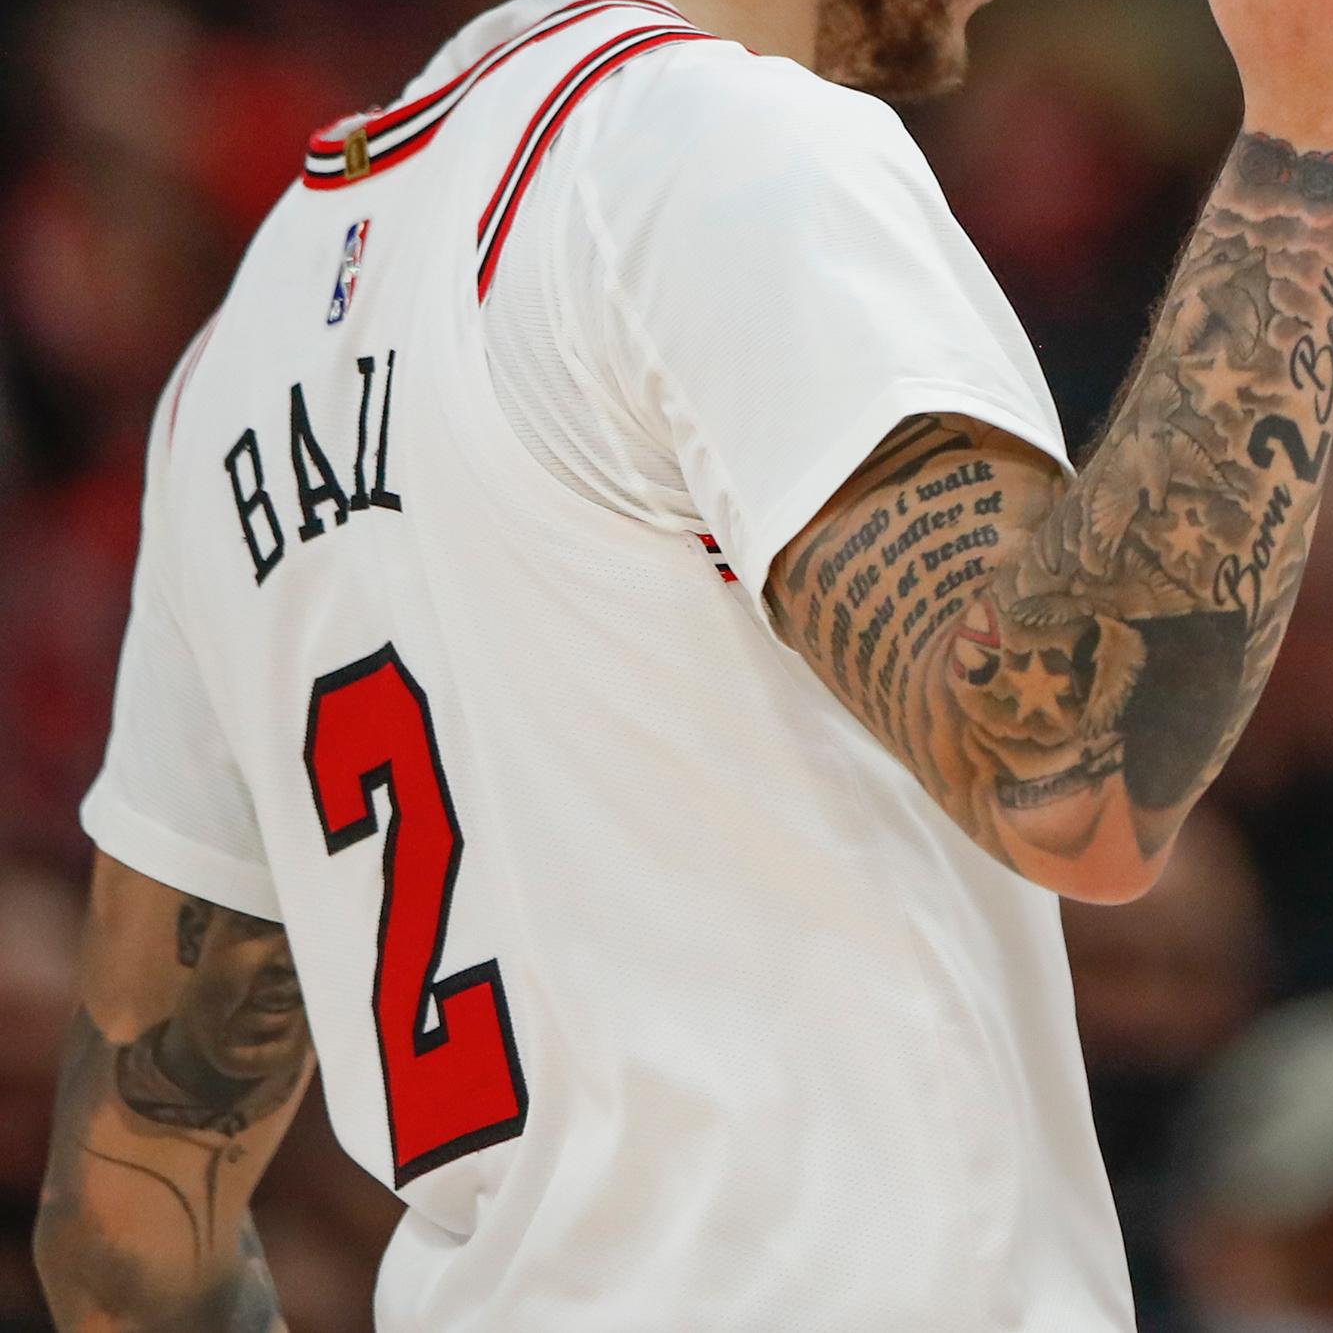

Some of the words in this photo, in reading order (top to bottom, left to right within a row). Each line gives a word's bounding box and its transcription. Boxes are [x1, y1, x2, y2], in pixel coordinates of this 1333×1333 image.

[916, 460, 995, 502] walk
[1247, 412, 1330, 484] 2
[974, 491, 1002, 515] of
[1213, 483, 1293, 623] Born
[303, 641, 529, 1191] 2
